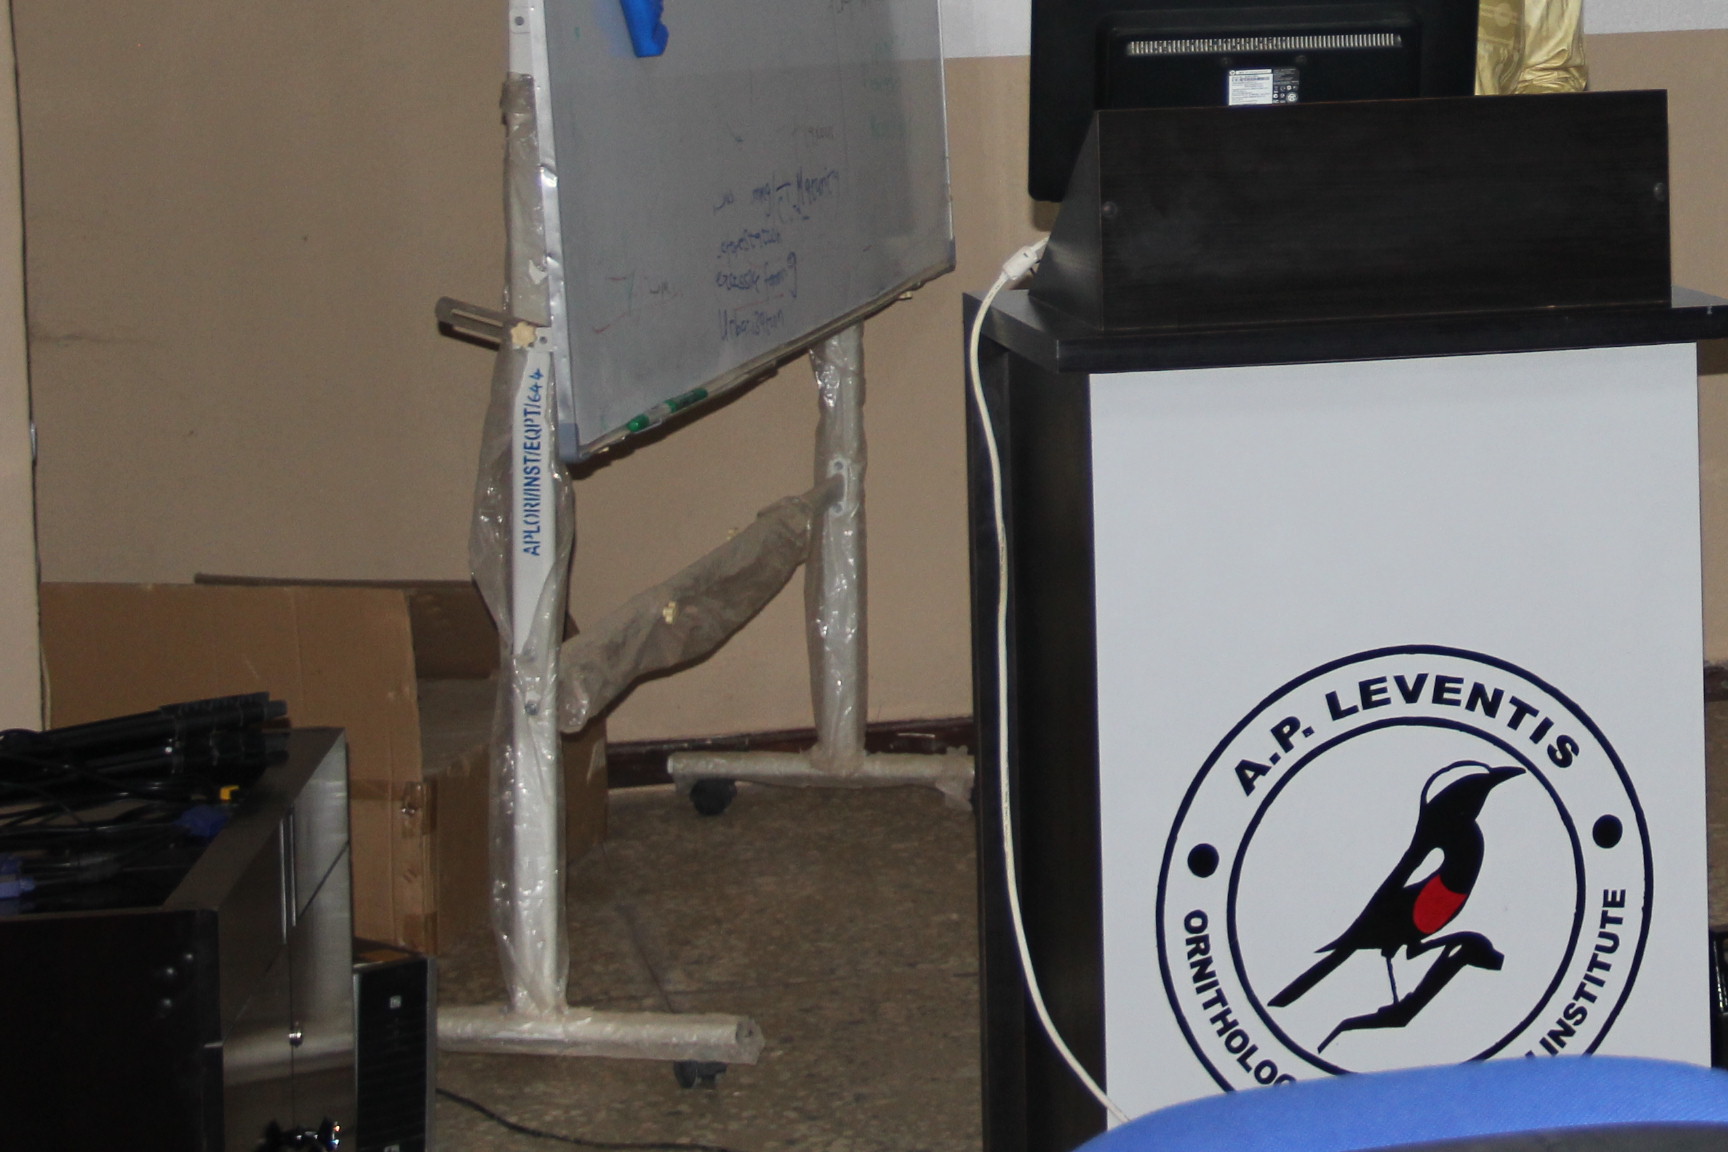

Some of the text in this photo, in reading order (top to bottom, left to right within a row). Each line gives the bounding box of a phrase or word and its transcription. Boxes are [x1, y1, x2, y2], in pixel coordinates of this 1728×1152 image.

[1234, 672, 1580, 797] A.P. LEVENTIS
[1539, 887, 1627, 1057] INSTITUTE
